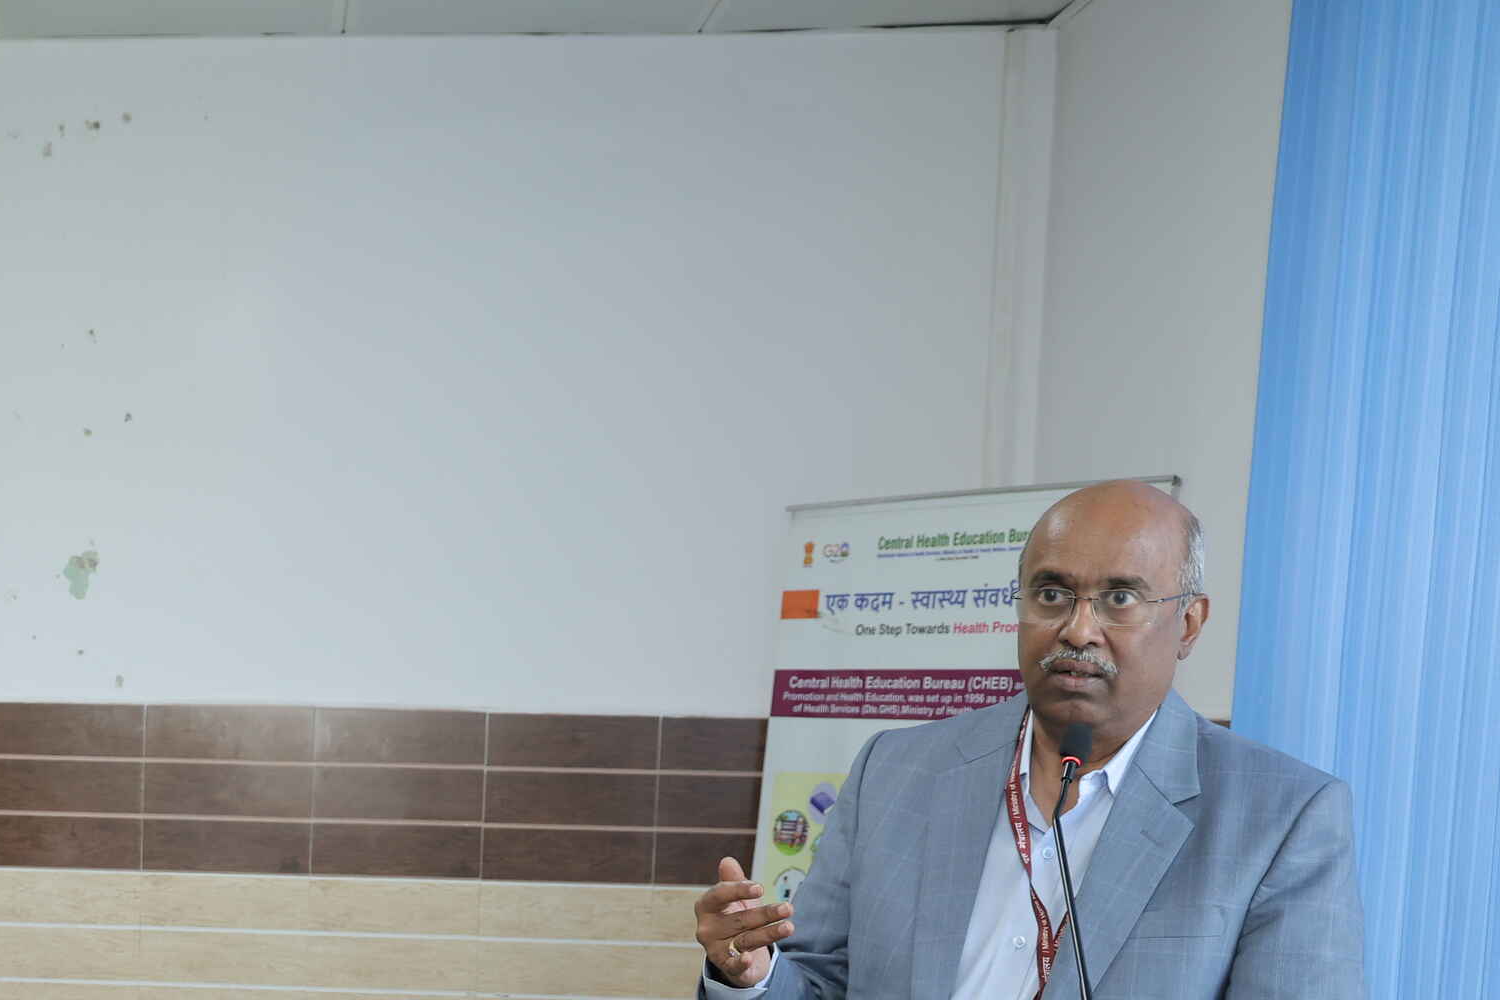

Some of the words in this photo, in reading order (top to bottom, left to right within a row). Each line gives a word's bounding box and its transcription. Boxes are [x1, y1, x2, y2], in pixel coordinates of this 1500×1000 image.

[878, 535, 914, 550] Central
[916, 532, 950, 548] Health
[953, 530, 1005, 546] Education
[825, 593, 850, 615] एक
[854, 591, 894, 612] कदम
[855, 623, 876, 636] One
[879, 622, 901, 637] Step
[905, 622, 949, 635] Towards
[953, 621, 989, 634] Health
[789, 675, 830, 689] Central
[830, 675, 863, 689] Health
[865, 676, 921, 689] Education
[923, 676, 966, 690] Bureau
[967, 676, 1014, 692] (CHEB)
